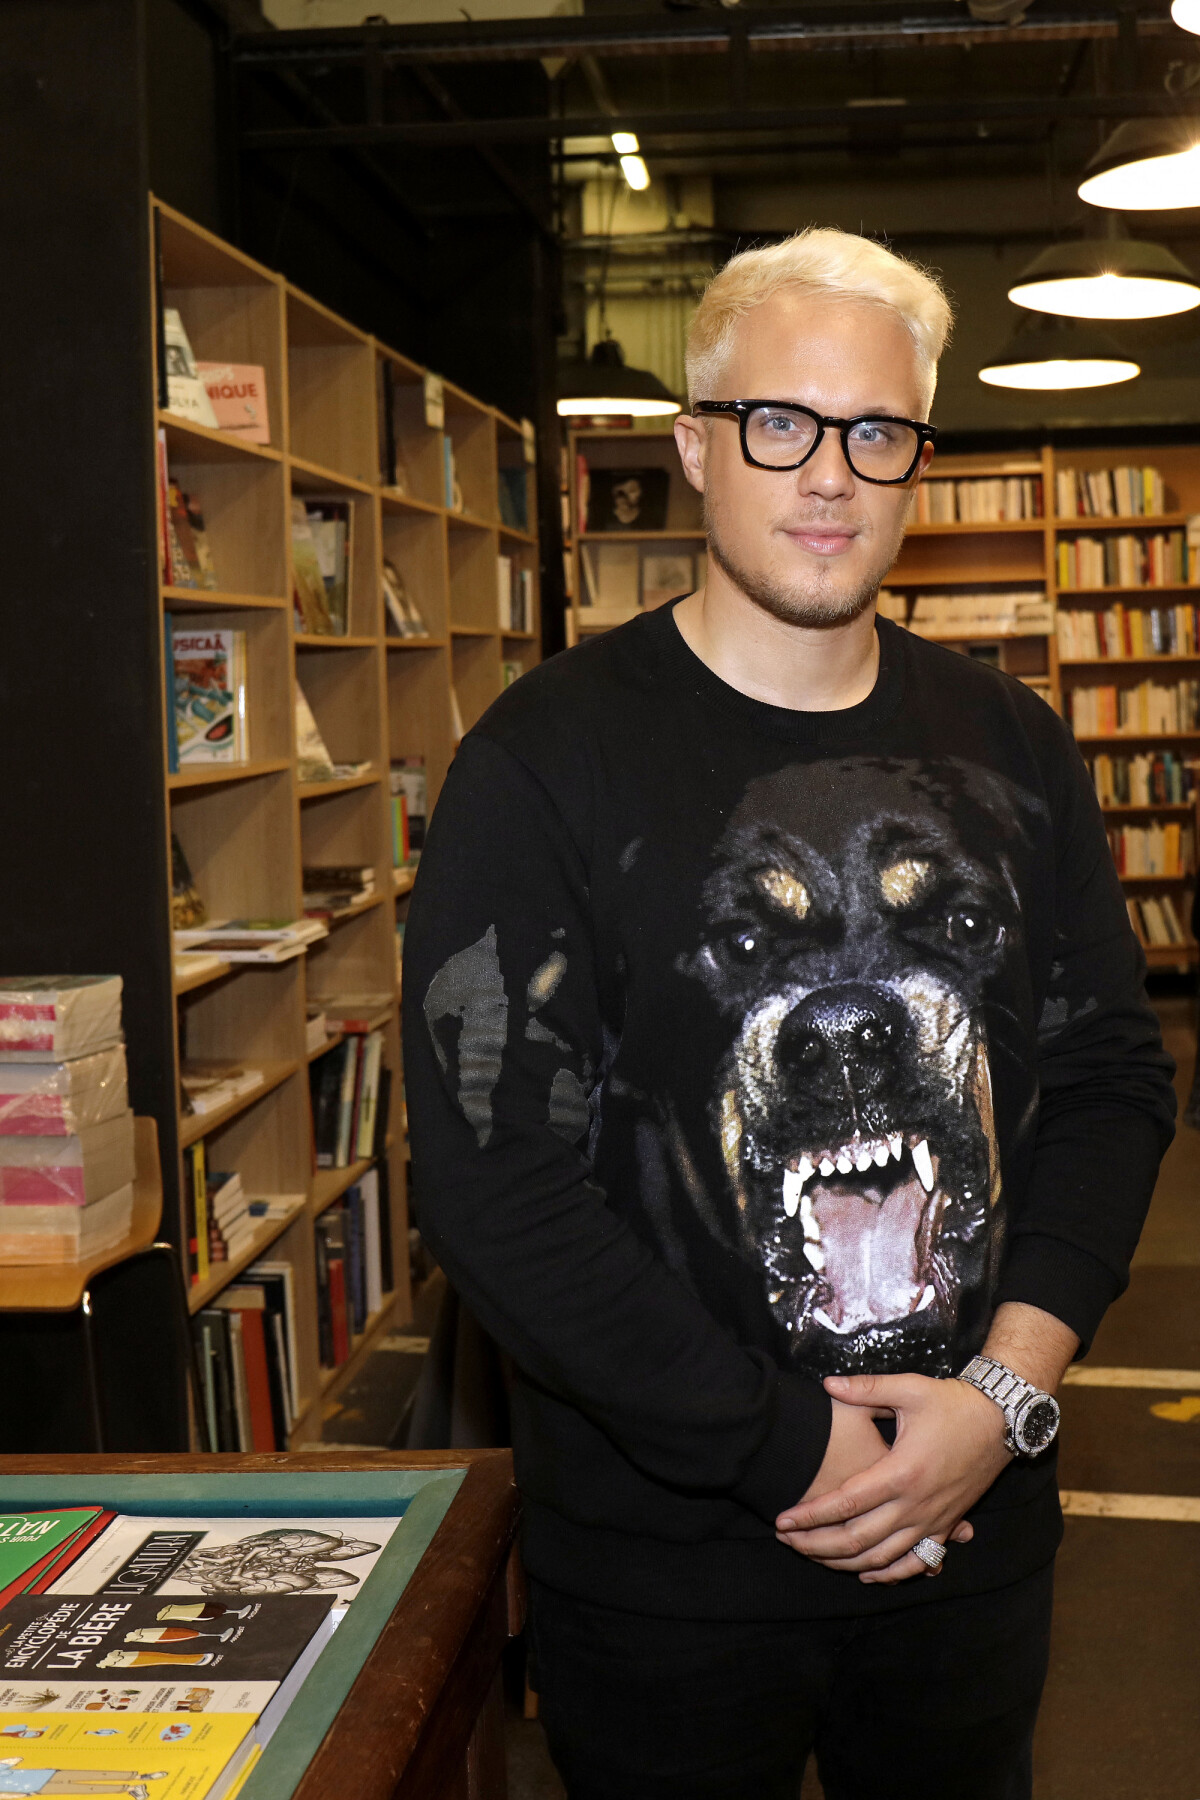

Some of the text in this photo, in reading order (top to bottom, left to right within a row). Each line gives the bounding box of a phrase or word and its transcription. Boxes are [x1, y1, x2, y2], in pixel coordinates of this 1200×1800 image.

[0, 1519, 61, 1537] NAT
[9, 1535, 42, 1543] POUR
[102, 1534, 193, 1595] LIGATURA
[4, 1602, 81, 1668] ENCYCLOPÉDIE
[9, 1638, 25, 1648] LA
[17, 1621, 43, 1640] PETITE
[46, 1603, 133, 1669] LA BIÈRE
[55, 1630, 72, 1639] DE
